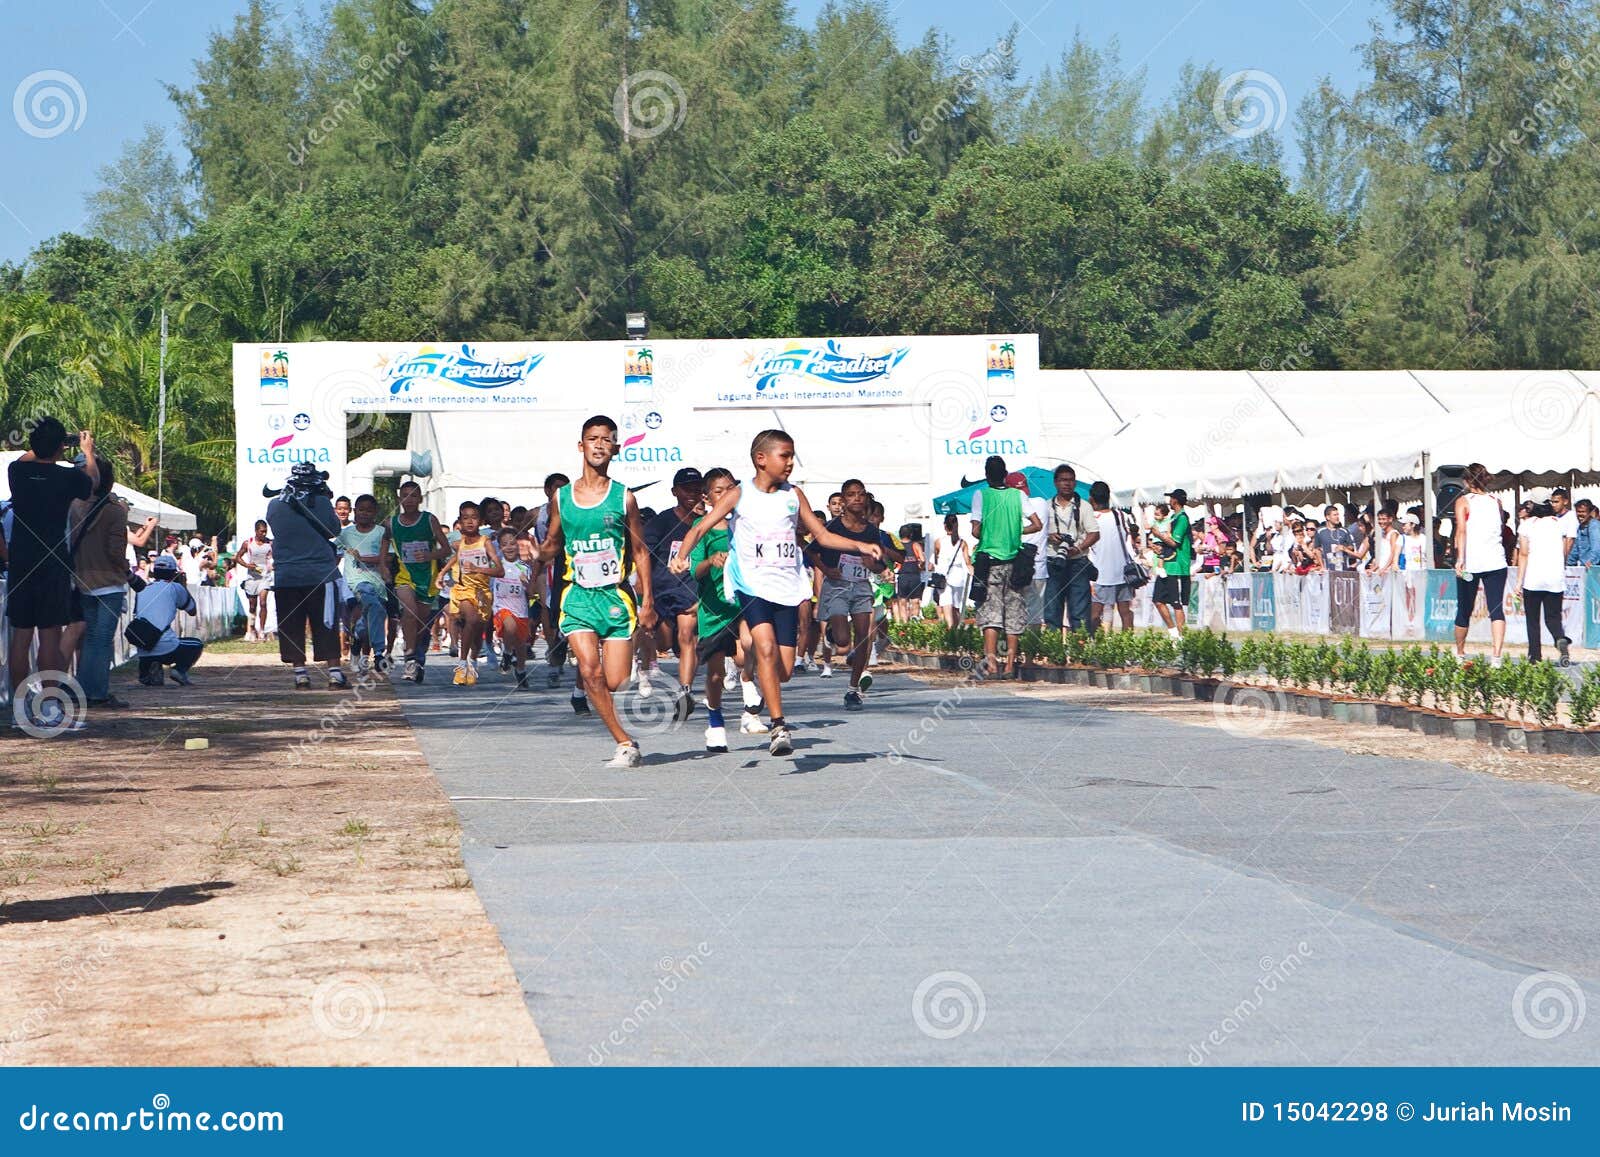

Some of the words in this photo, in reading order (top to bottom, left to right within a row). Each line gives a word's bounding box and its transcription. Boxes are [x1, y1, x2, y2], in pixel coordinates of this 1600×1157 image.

[351, 395, 387, 405] Laguna
[389, 395, 423, 404] Phuket
[428, 395, 490, 404] International
[492, 395, 538, 404] Marathon
[717, 392, 752, 402] Laguna
[755, 391, 789, 400] Phuket
[793, 390, 853, 400] International
[858, 389, 903, 398] Marathon
[755, 543, 764, 558] K
[776, 542, 795, 558] 132
[475, 555, 488, 566] 70
[577, 565, 586, 580] K
[601, 559, 619, 577] 92
[853, 565, 868, 578] 121
[509, 585, 521, 594] 35
